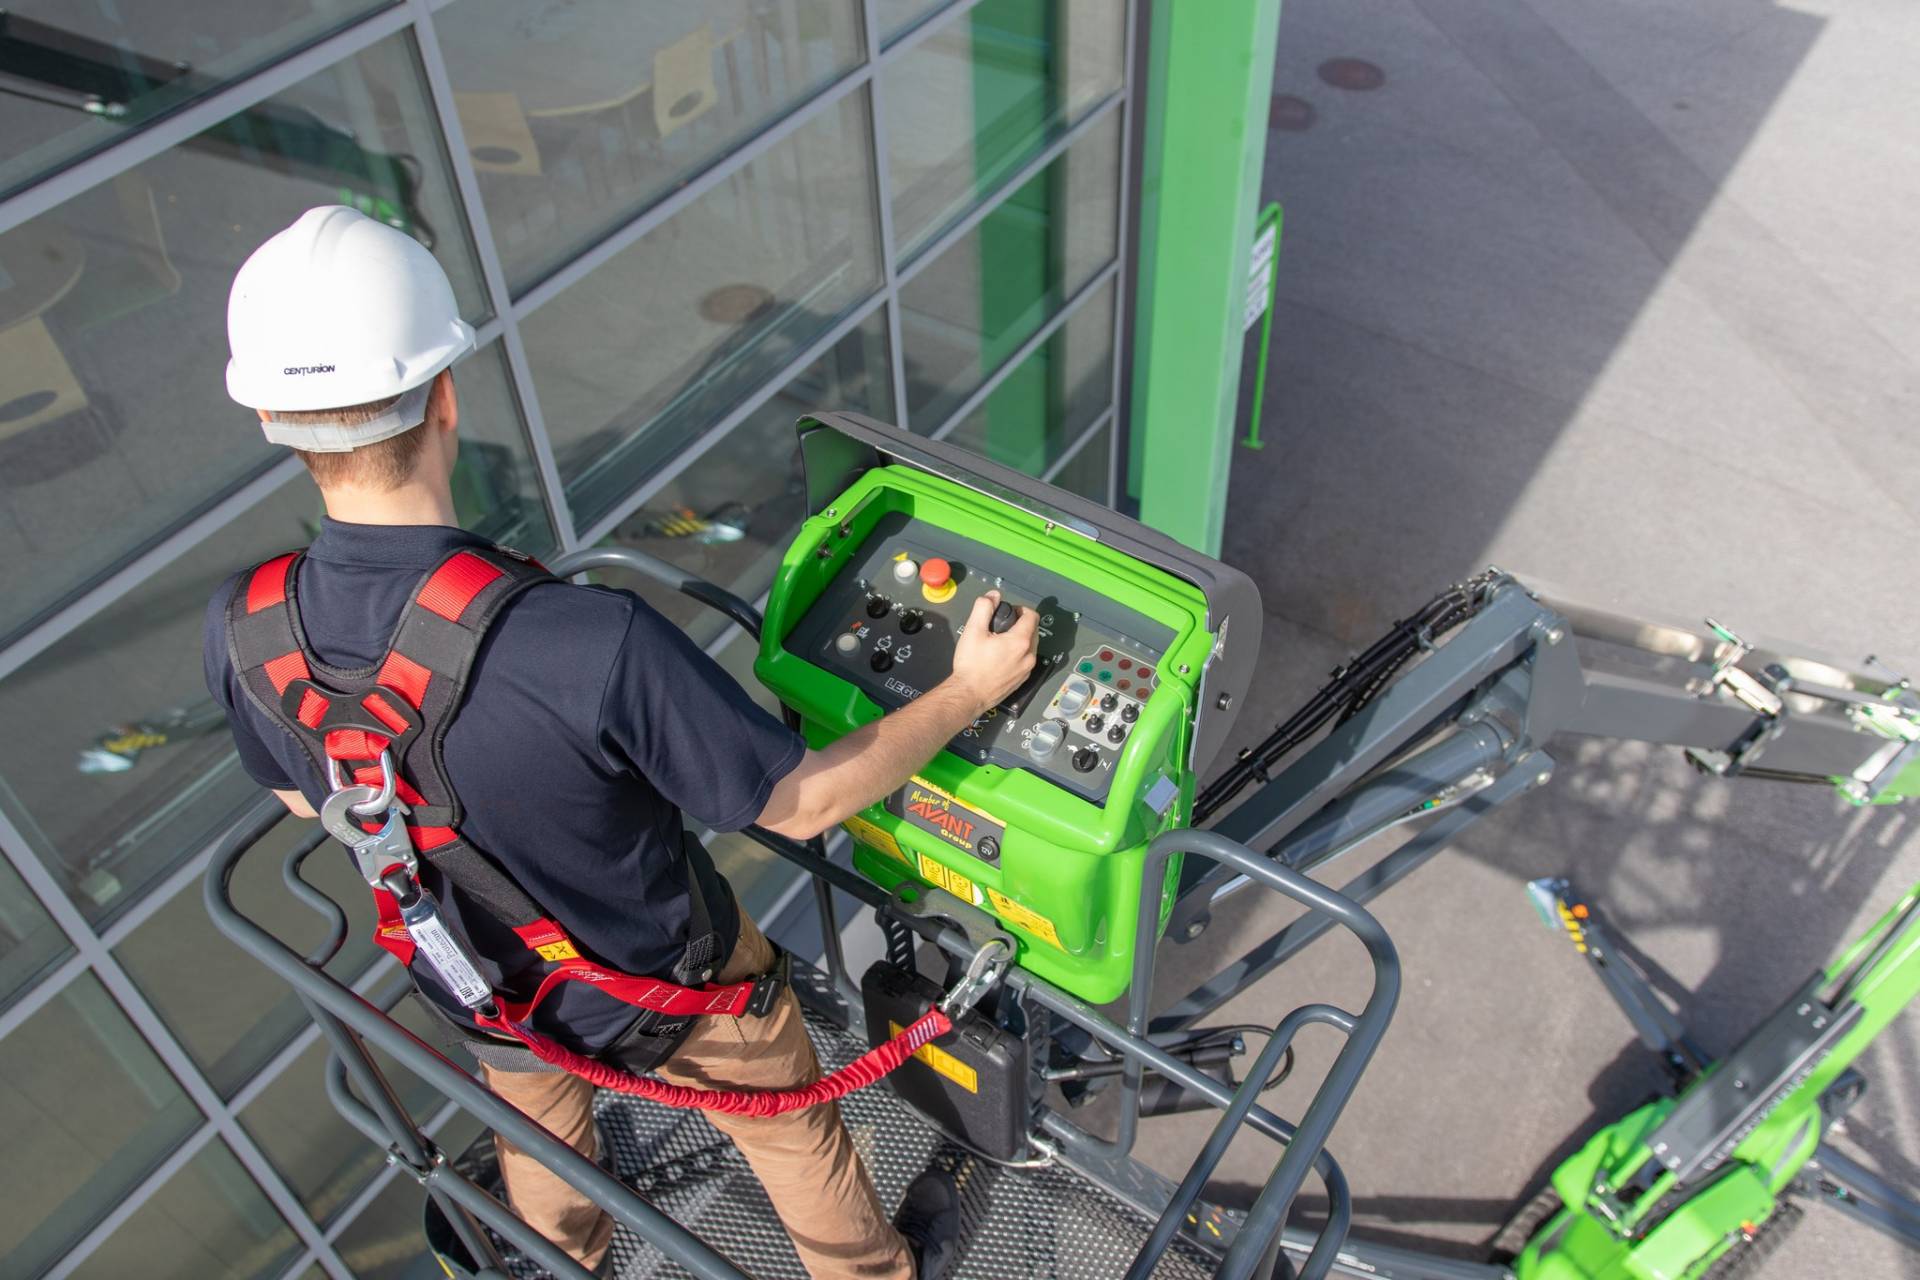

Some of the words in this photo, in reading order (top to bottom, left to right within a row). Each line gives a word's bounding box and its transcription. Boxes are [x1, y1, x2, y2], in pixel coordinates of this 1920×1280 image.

[283, 363, 336, 377] CENTURION
[884, 677, 923, 700] LEGU
[910, 790, 941, 805] Member
[942, 800, 951, 811] of
[907, 802, 975, 840] AVANT
[940, 828, 973, 849] Group
[981, 846, 993, 856] 12V
